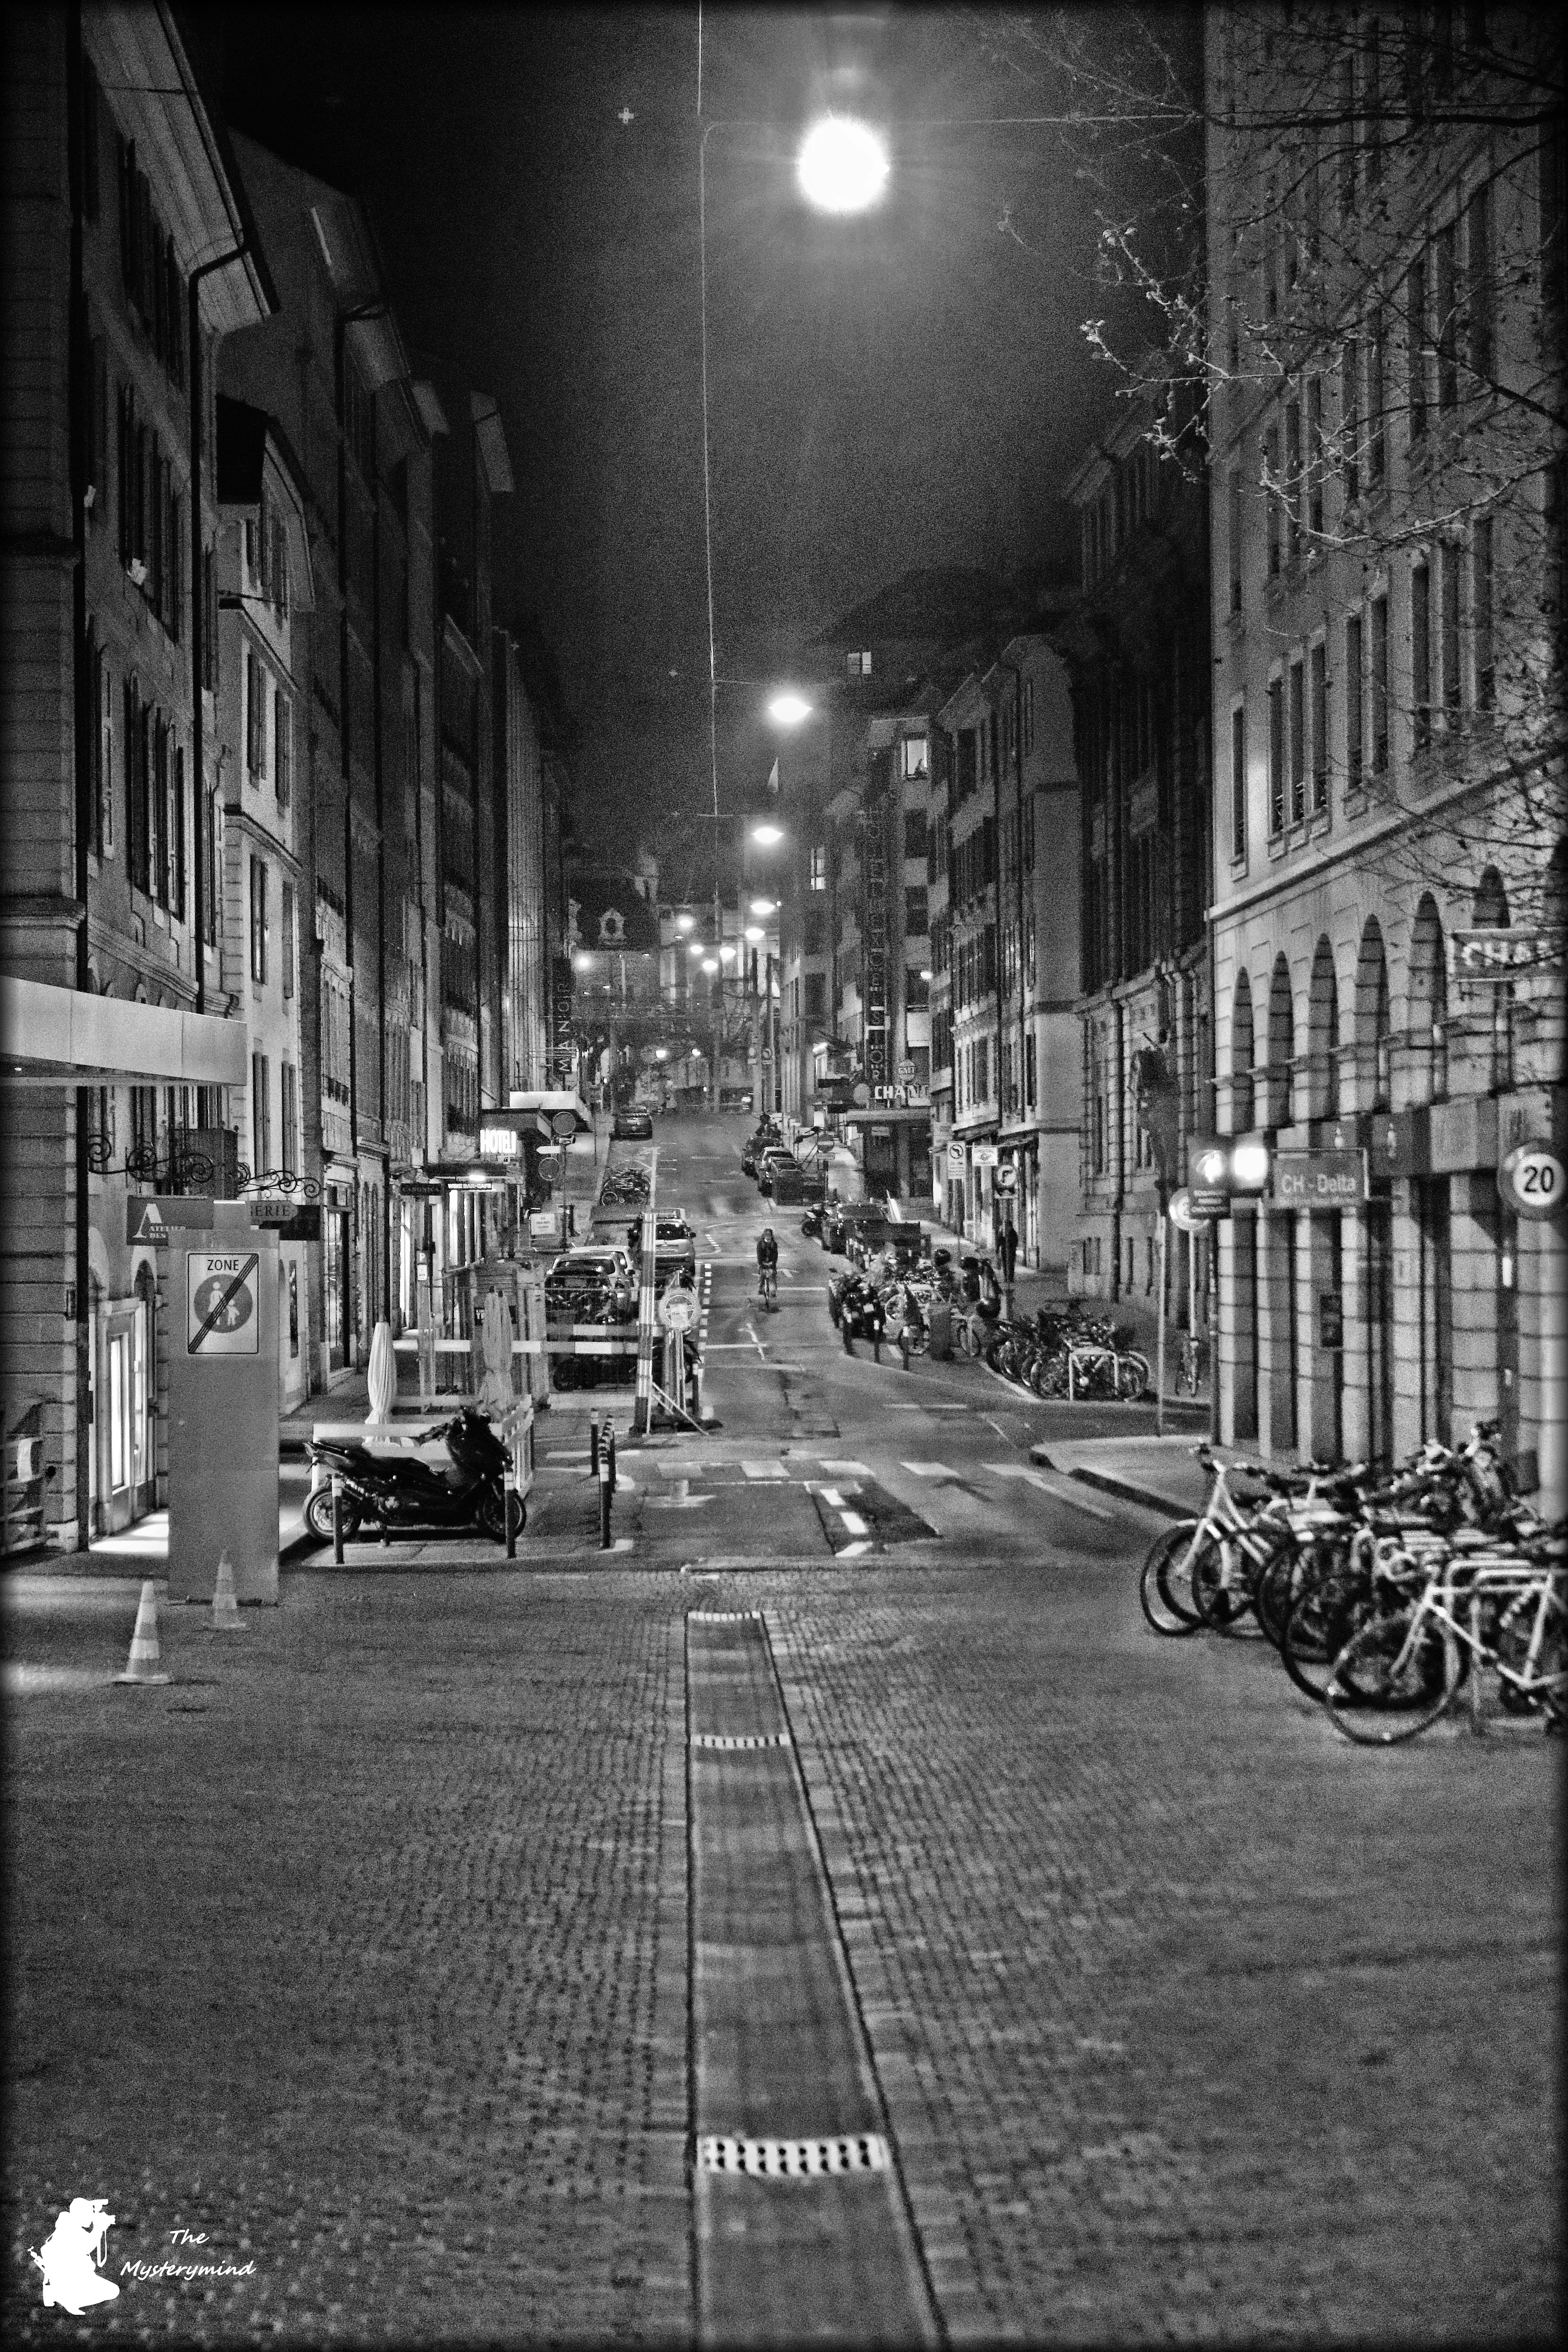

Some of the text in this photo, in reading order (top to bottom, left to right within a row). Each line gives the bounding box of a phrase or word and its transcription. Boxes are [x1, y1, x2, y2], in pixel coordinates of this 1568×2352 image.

[1524, 1165, 1554, 1193] 20
[250, 1206, 290, 1216] ERIE
[207, 1259, 240, 1271] ZONE
